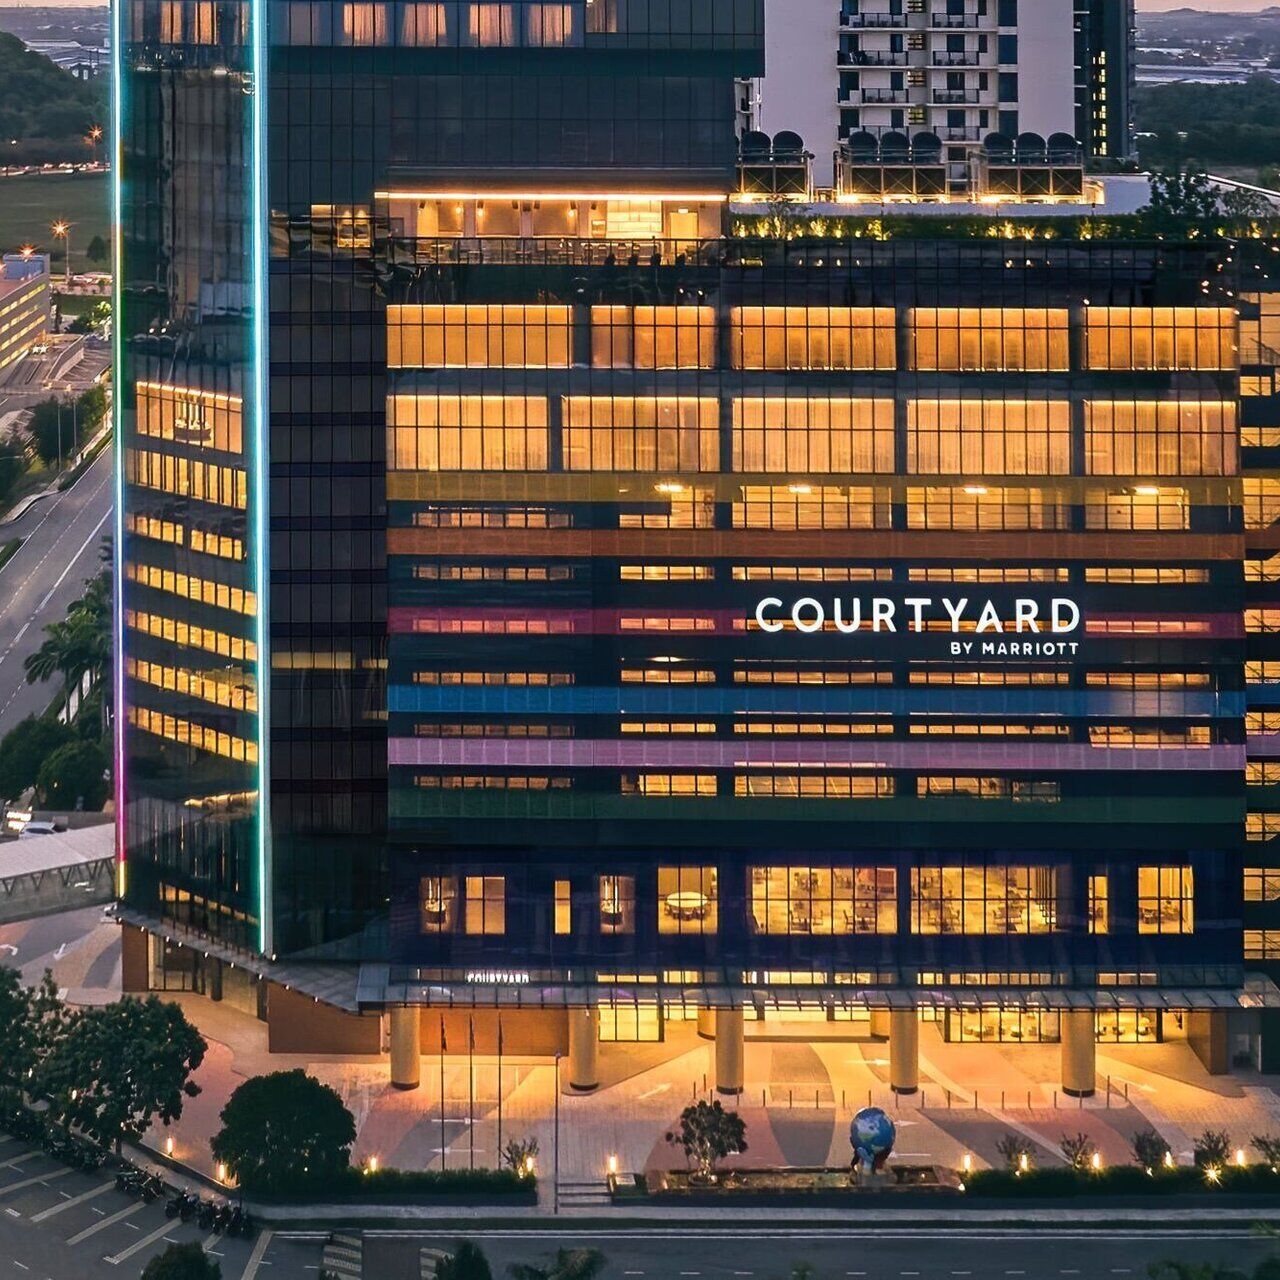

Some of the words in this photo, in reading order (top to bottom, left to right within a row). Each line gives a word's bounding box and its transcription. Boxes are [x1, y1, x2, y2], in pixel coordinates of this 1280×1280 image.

[755, 597, 1080, 633] COURTYARD
[950, 641, 973, 656] BY
[982, 642, 1079, 656] MARRIOTT
